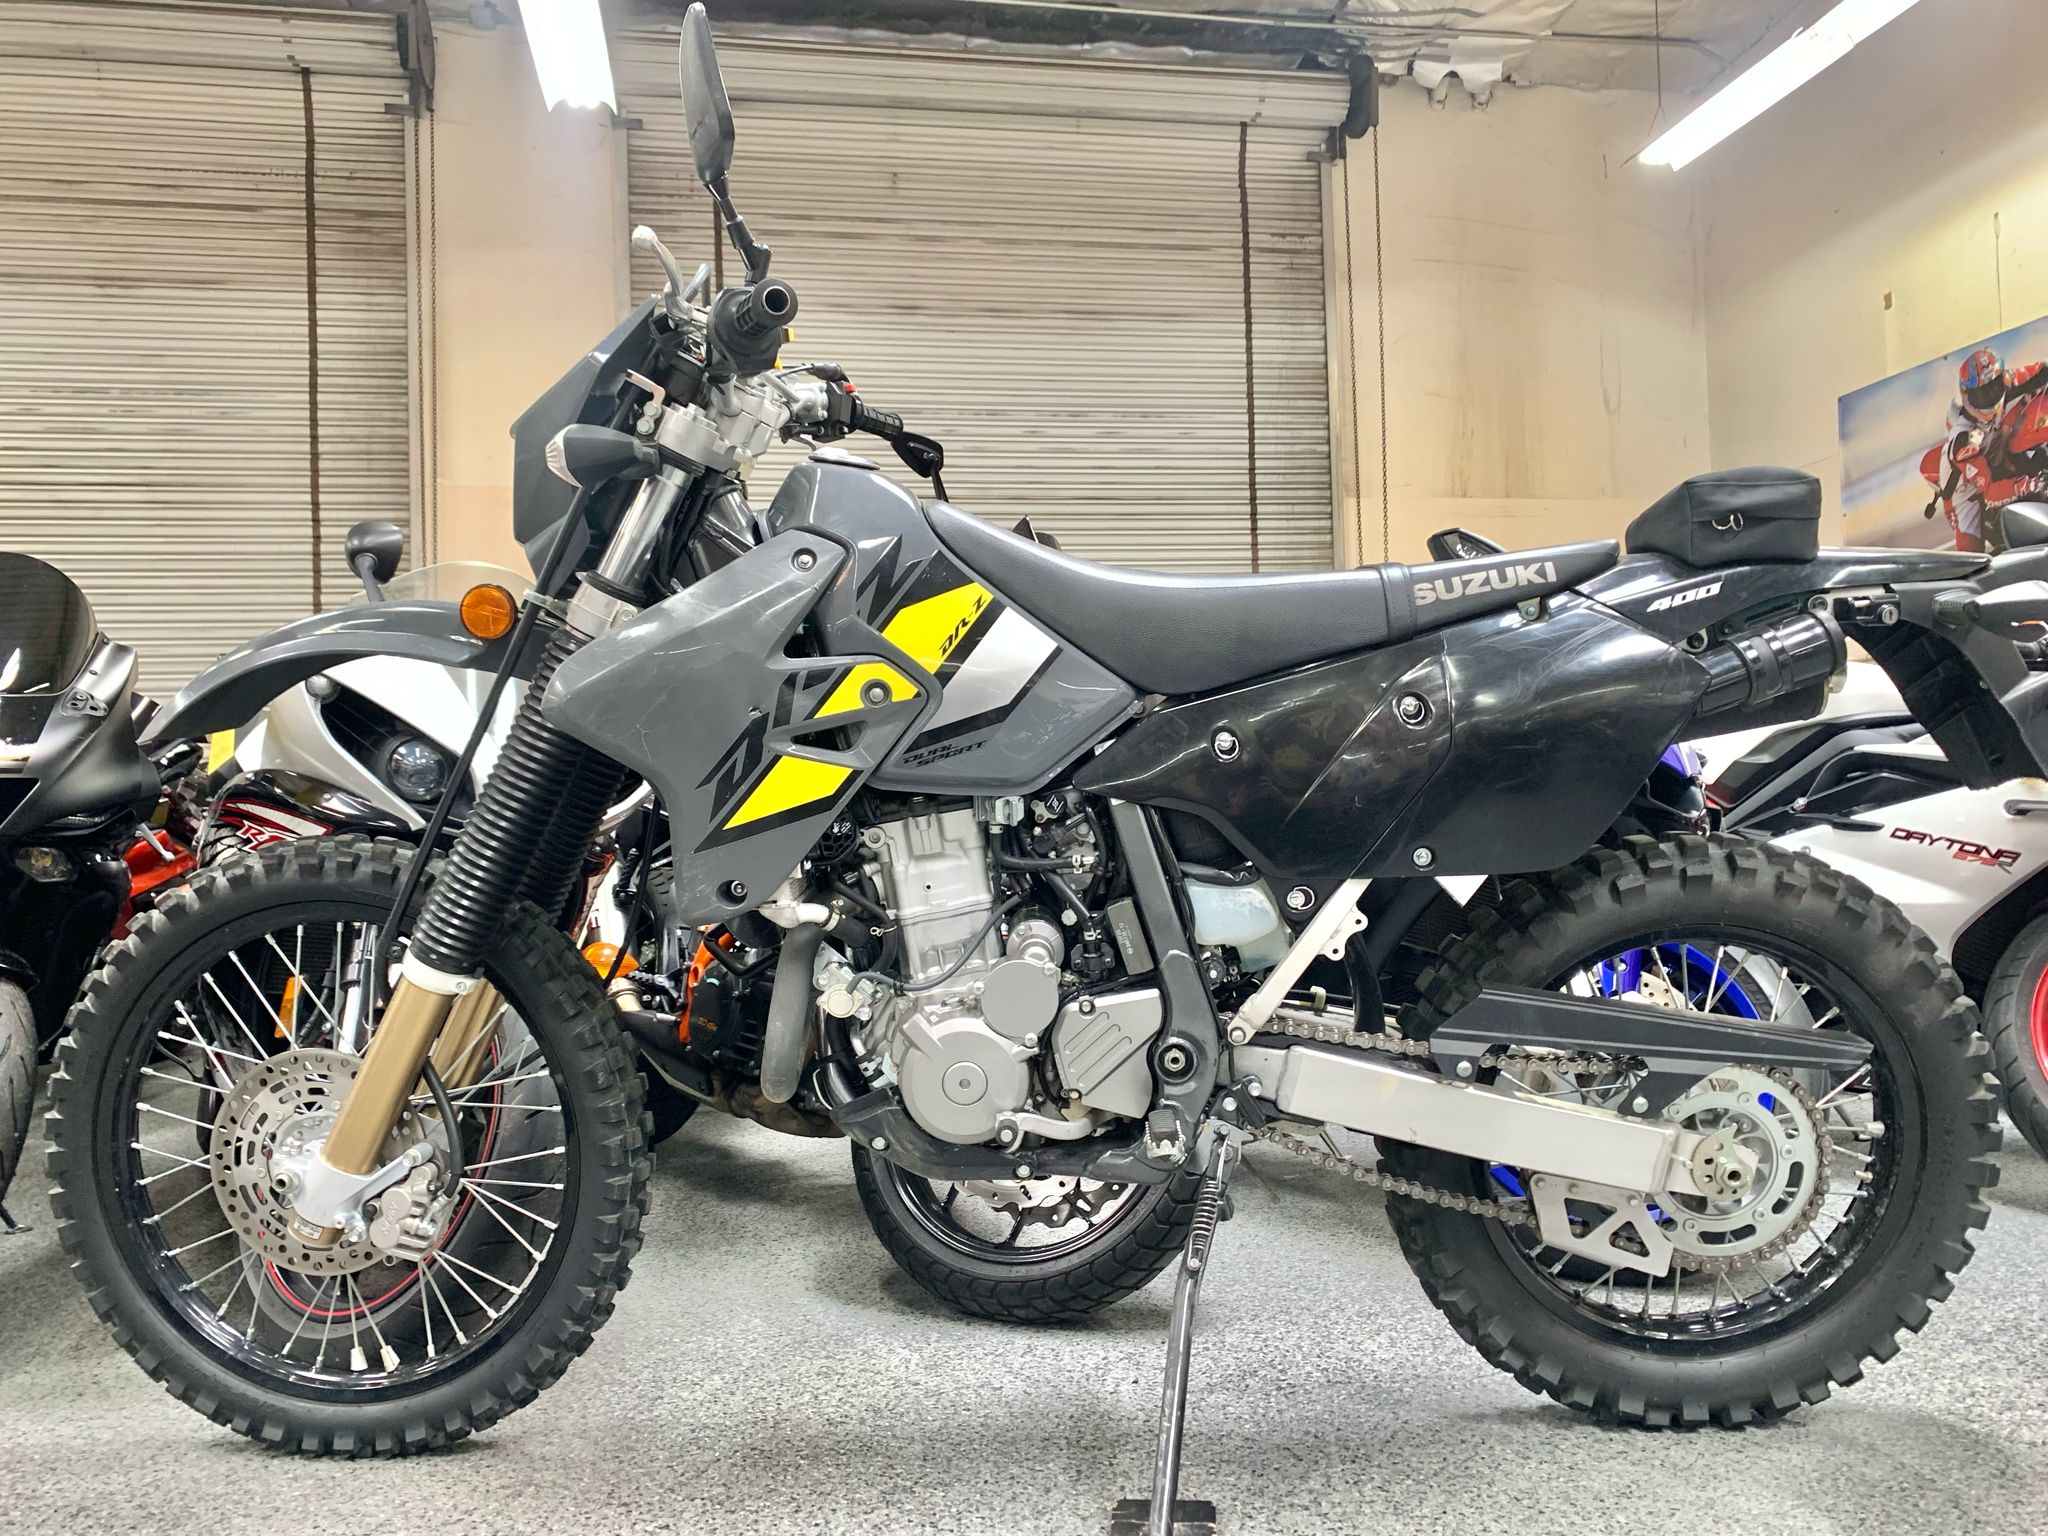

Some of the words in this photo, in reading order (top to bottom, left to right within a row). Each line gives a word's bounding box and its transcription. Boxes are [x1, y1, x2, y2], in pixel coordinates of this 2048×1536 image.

[1413, 561, 1558, 606] SUZUKI
[1646, 581, 1724, 613] 400
[938, 594, 987, 657] DR-Z
[903, 744, 960, 764] DUAL
[916, 740, 988, 767] SPORT
[1889, 827, 2022, 864] DAYTONA
